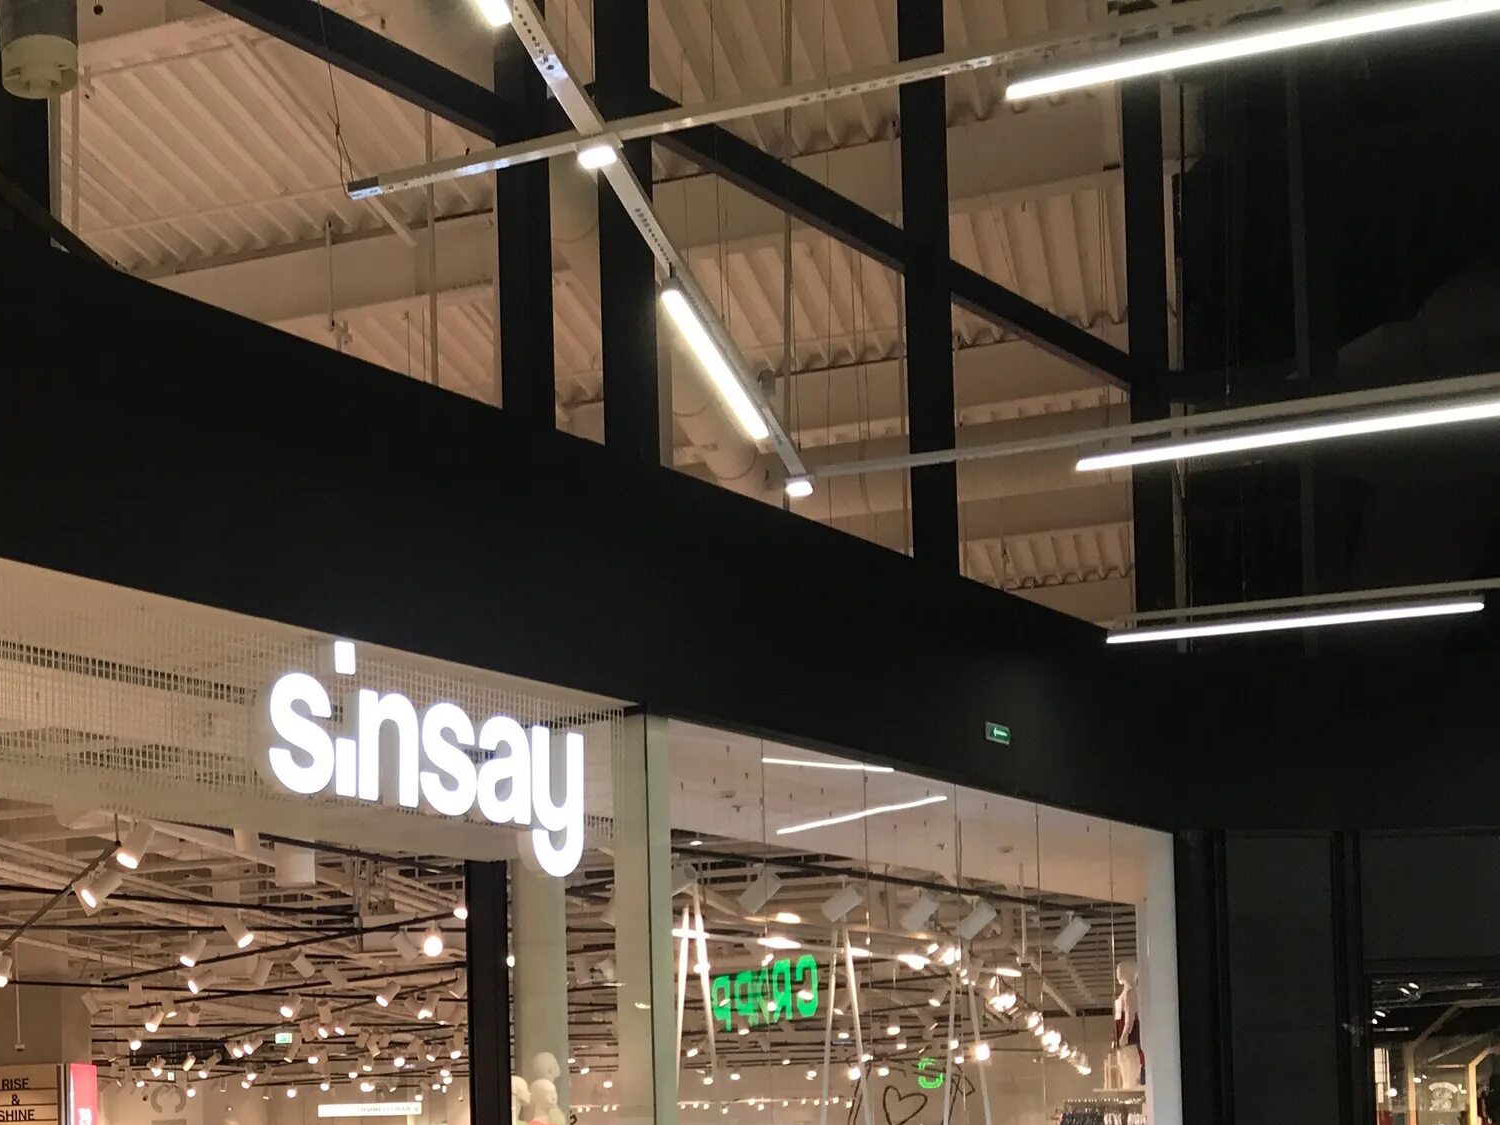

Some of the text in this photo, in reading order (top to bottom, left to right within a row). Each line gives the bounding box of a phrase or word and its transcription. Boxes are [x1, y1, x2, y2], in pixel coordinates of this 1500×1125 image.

[268, 641, 583, 877] sinsay
[2, 1078, 29, 1091] RISE
[11, 1094, 20, 1106] &
